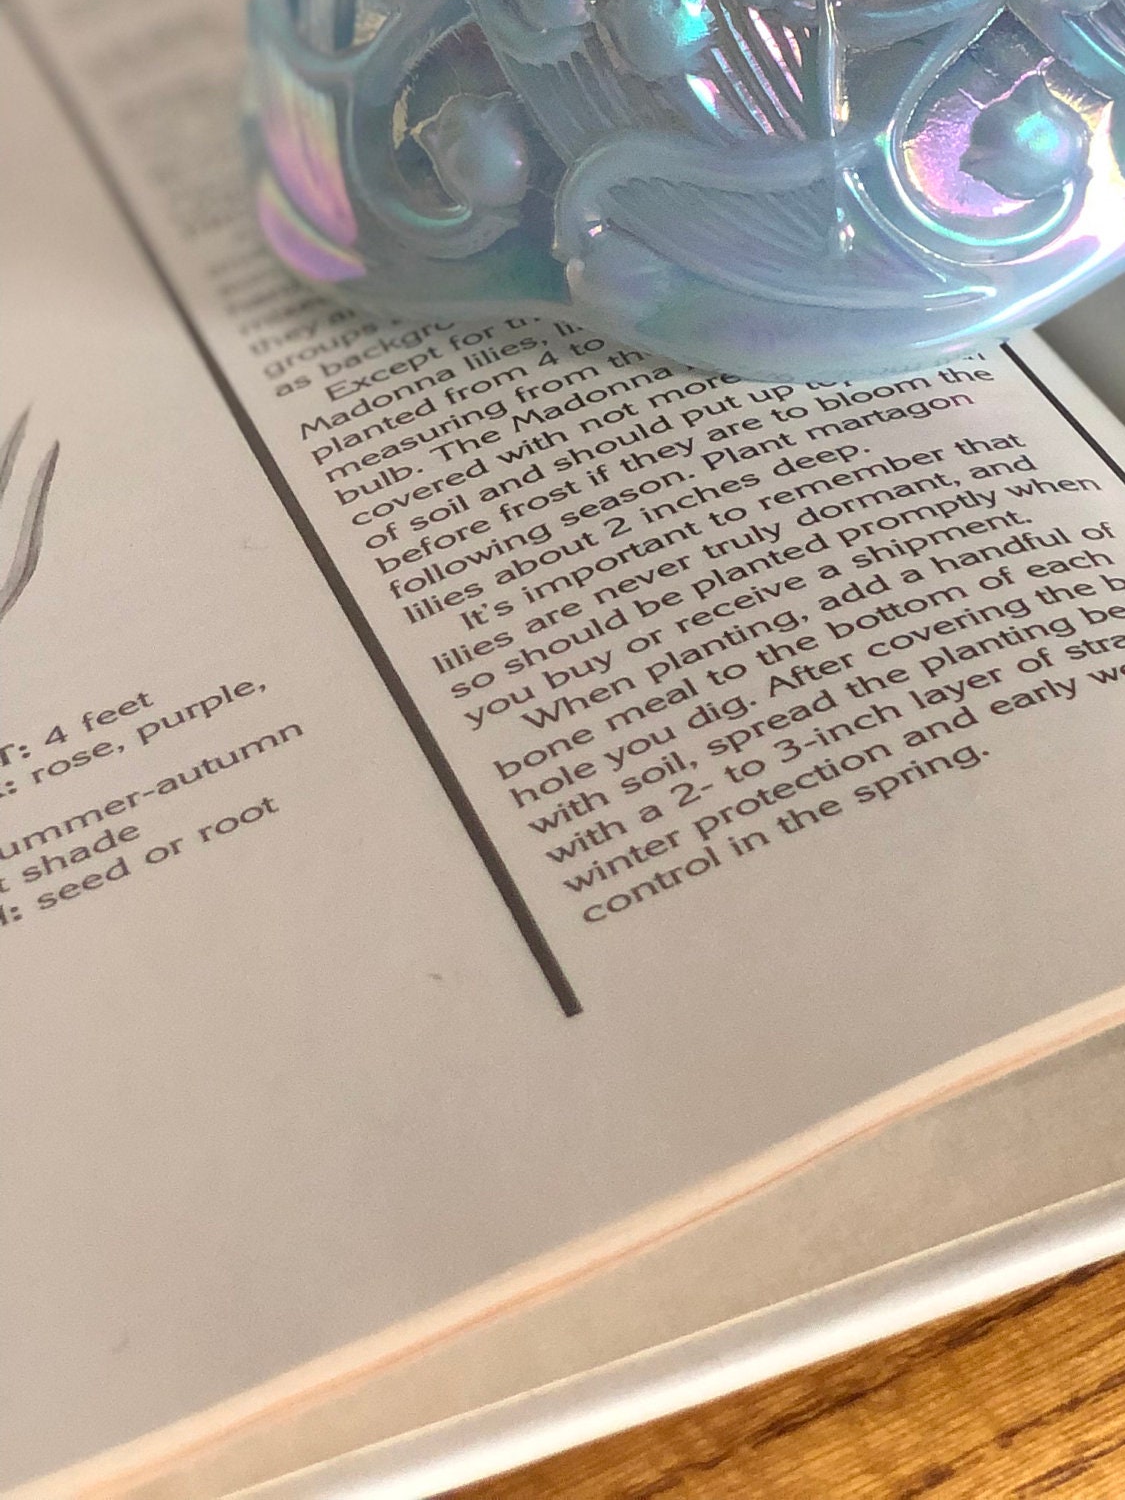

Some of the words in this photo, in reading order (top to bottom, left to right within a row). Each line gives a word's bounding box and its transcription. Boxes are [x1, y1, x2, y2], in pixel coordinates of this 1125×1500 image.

[263, 320, 379, 380] groups
[276, 373, 312, 398] as
[301, 369, 456, 440] Madonna
[463, 335, 549, 371] lilies,
[311, 397, 438, 466] planted
[444, 367, 528, 405] from
[538, 350, 560, 368] 4
[569, 337, 606, 357] to
[324, 346, 443, 402] Except
[450, 324, 495, 351] for
[325, 400, 508, 483] measuring
[515, 365, 600, 404] from
[334, 467, 423, 506] bulb.
[429, 430, 501, 462] The
[512, 366, 674, 433] Madonna
[352, 458, 490, 525] covered
[496, 431, 569, 463] with
[578, 403, 639, 434] not
[647, 373, 742, 409] more
[366, 522, 399, 549] of
[410, 494, 470, 531] soil
[479, 464, 546, 502] and
[553, 415, 674, 472] should
[680, 396, 742, 428] put
[747, 384, 794, 402] up
[374, 520, 491, 575] before
[499, 480, 582, 522] frost
[586, 464, 610, 486] if
[620, 437, 693, 472] they
[707, 418, 763, 442] are
[770, 407, 808, 422] to
[814, 378, 932, 412] bloom
[938, 368, 994, 384] the
[390, 523, 552, 599] following
[560, 471, 695, 527] season.
[700, 433, 797, 471] Plant
[805, 394, 974, 440] martagon
[403, 583, 484, 624] lilies
[495, 532, 599, 585] about
[603, 517, 632, 538] 2
[640, 474, 760, 524] inches
[773, 445, 870, 476] deep.
[432, 632, 514, 674] lilies
[525, 603, 582, 634] are
[593, 556, 690, 604] never
[702, 522, 780, 559] truly
[797, 473, 960, 526] dormant,
[969, 455, 1038, 479] and
[451, 672, 495, 698] so
[504, 608, 630, 675] should
[632, 592, 684, 618] be
[691, 533, 831, 600] planted
[837, 485, 998, 548] promptly
[1007, 474, 1103, 503] when
[459, 601, 514, 631] It's
[521, 522, 703, 604] important
[708, 507, 747, 526] to
[758, 449, 945, 511] remember
[954, 434, 1026, 455] that
[464, 686, 535, 731] you
[541, 650, 611, 690] buy
[627, 629, 662, 653] or
[674, 576, 807, 634] receive
[818, 565, 842, 579] a
[852, 511, 1032, 569] shipment.
[493, 729, 594, 780] bone
[605, 678, 699, 731] meal
[706, 664, 747, 685] to
[755, 636, 819, 666] the
[824, 587, 969, 640] bottom
[979, 566, 1015, 590] of
[1027, 550, 1115, 578] each
[509, 763, 596, 808] hole
[603, 726, 677, 772] you
[688, 695, 757, 729] dig.
[770, 653, 853, 698] After
[867, 598, 1031, 657] covering
[1035, 584, 1097, 605] the
[520, 677, 636, 728] When
[645, 611, 808, 685] planting,
[818, 574, 892, 611] add
[900, 569, 925, 584] a
[928, 528, 1072, 574] handful
[1081, 522, 1116, 540] of
[0, 724, 303, 860] ummer-autumn
[31, 742, 124, 784] rose,
[136, 682, 266, 745] purple,
[45, 726, 68, 745] 4
[82, 693, 154, 732] feet
[528, 792, 610, 834] with
[621, 751, 697, 794] soil,
[707, 689, 839, 756] spread
[845, 669, 910, 698] the
[919, 617, 1076, 678] planting
[546, 821, 628, 863] with
[639, 805, 664, 823] a
[670, 783, 713, 808] 2-
[724, 760, 765, 783] to
[773, 704, 903, 763] 3-inch
[908, 668, 1002, 709] layer
[1017, 647, 1054, 673] of
[563, 830, 679, 892] winter
[692, 744, 893, 841] protection
[903, 706, 979, 747] and
[990, 677, 1076, 715] early
[22, 826, 140, 883] shade
[37, 857, 131, 910] seed
[145, 838, 183, 864] or
[198, 797, 279, 842] root
[583, 846, 721, 922] control
[728, 832, 770, 857] in
[777, 800, 843, 834] the
[854, 745, 989, 804] spring.
